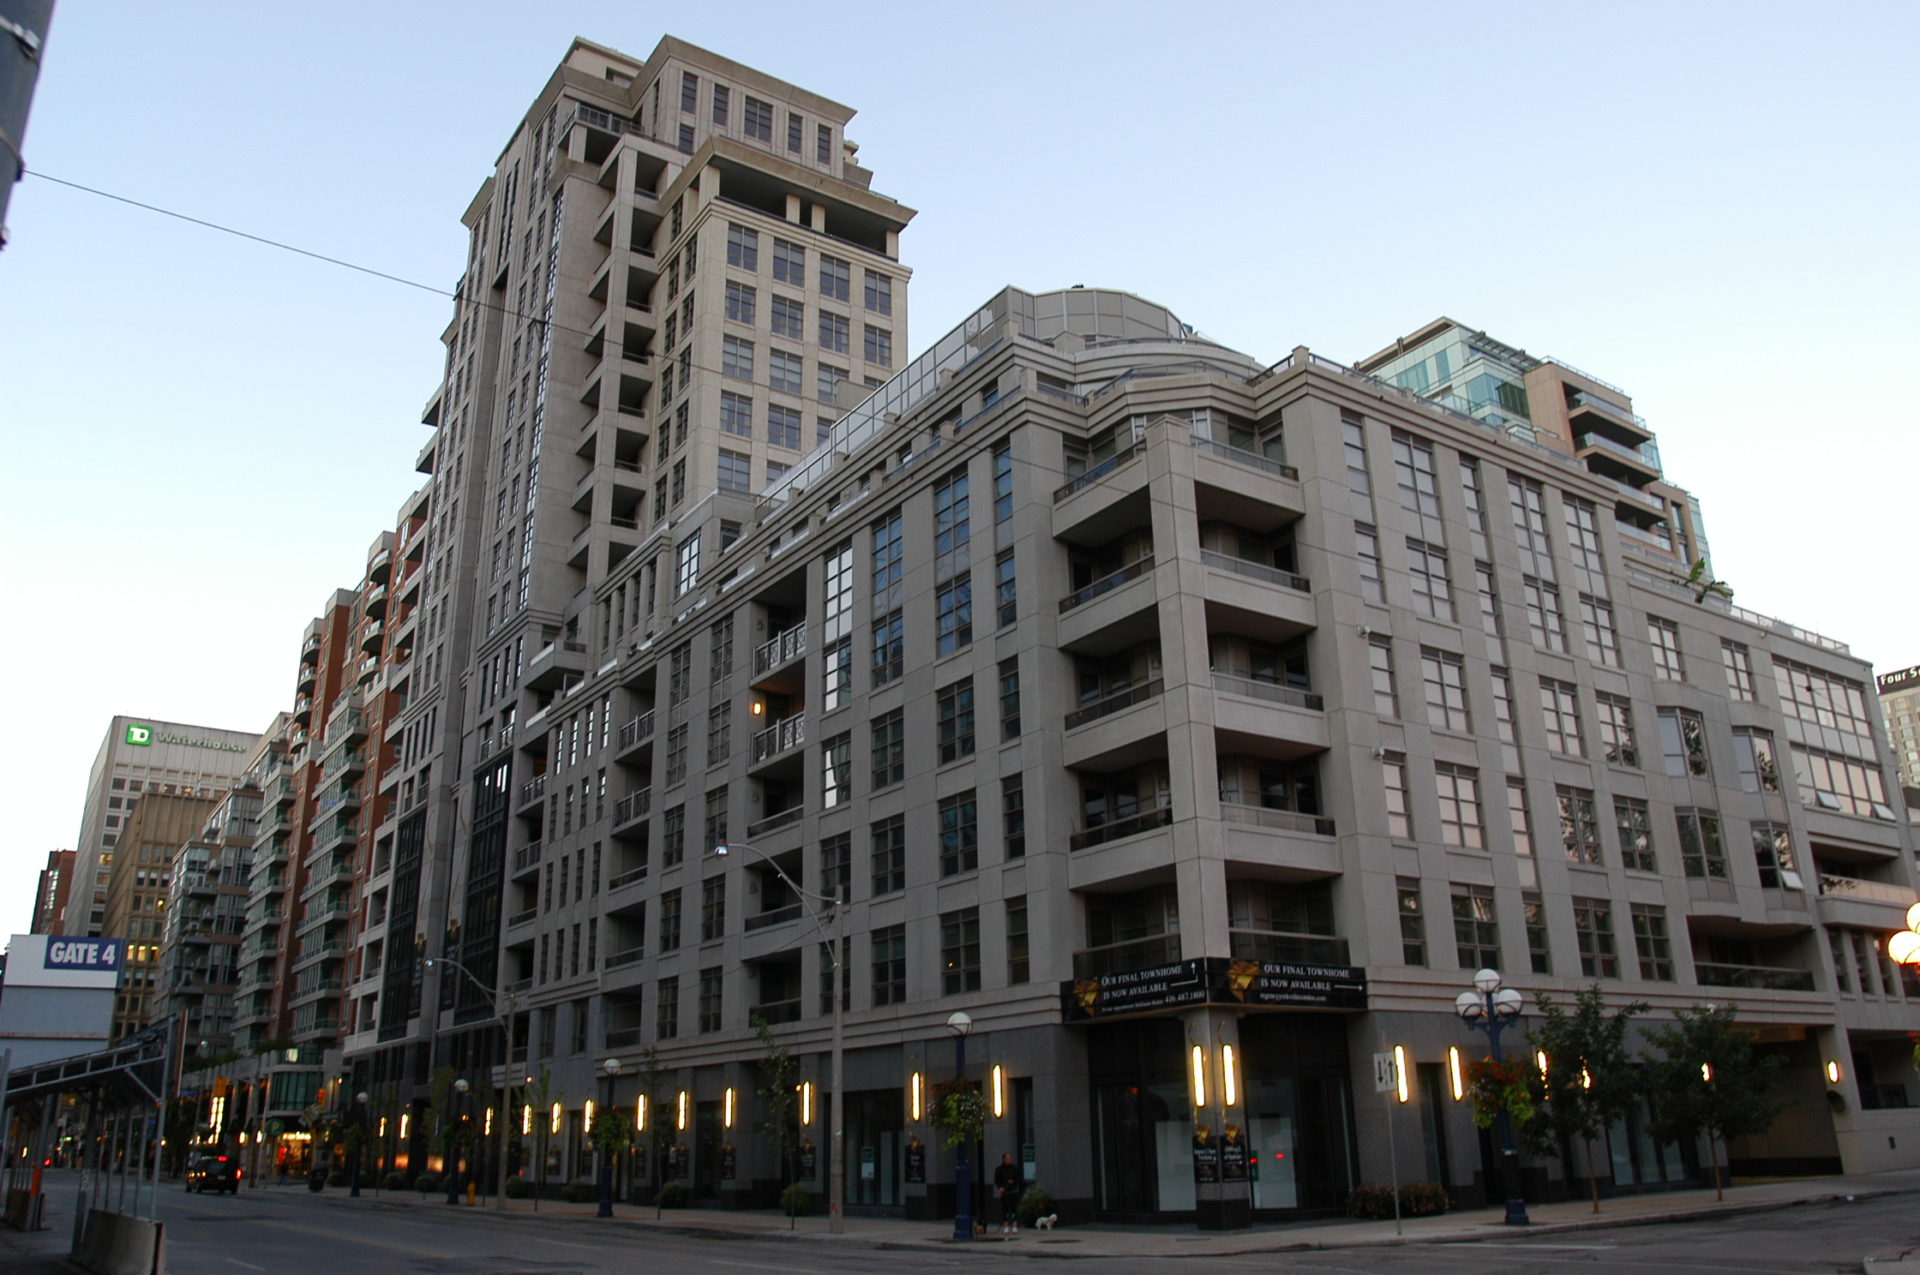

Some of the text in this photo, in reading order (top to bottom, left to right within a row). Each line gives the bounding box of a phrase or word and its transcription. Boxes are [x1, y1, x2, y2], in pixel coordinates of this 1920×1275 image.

[1880, 671, 1907, 686] Four
[129, 726, 247, 752] TD Waterhouse
[50, 942, 116, 965] GATE 4
[1101, 965, 1182, 987] OUR FINAL TOWNHOME
[1264, 964, 1350, 978] OUR FINAL TOWNHOME
[1103, 982, 1168, 1000] IS NOW AVAILABLE
[1261, 978, 1331, 991] IS NOW AVAILABLE
